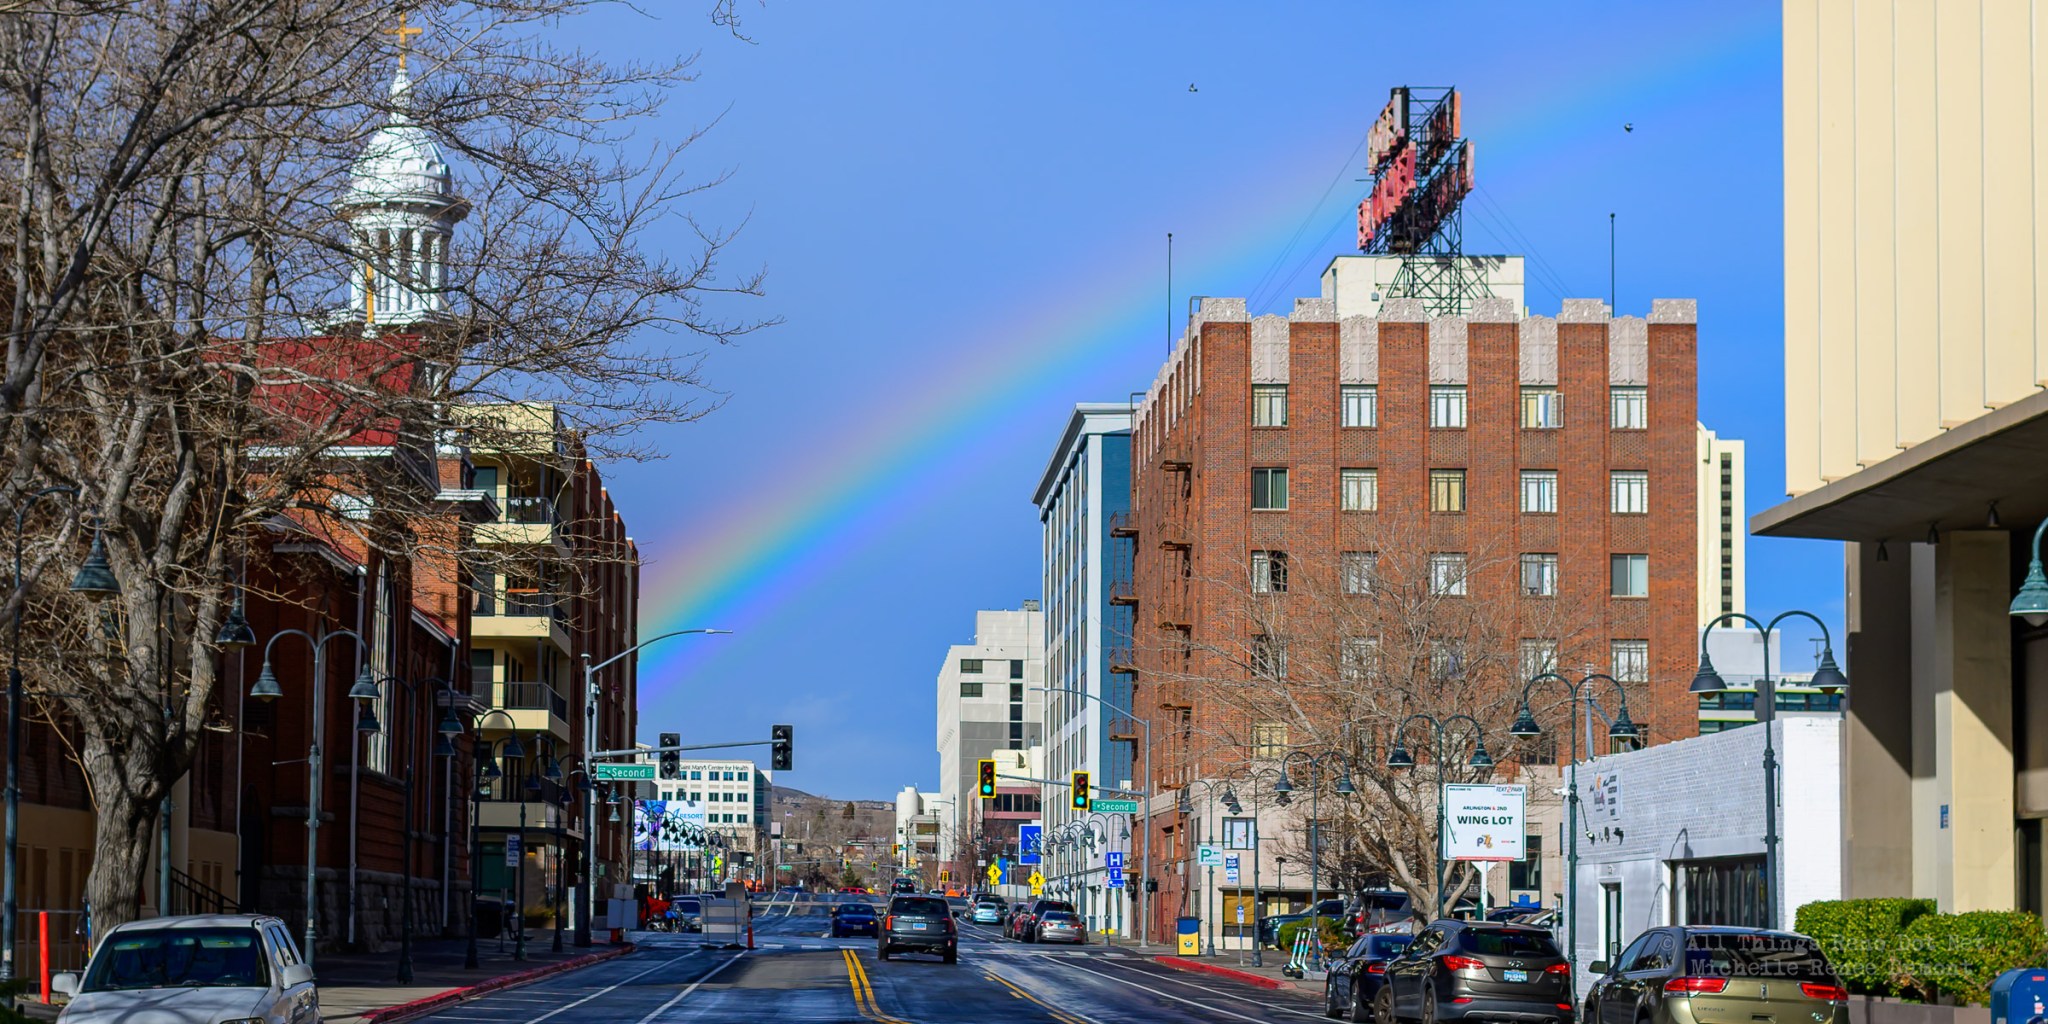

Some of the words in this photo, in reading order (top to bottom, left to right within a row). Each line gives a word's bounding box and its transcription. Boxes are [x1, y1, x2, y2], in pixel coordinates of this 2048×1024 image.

[611, 767, 646, 778] Second
[1101, 802, 1129, 811] Second
[1457, 815, 1489, 825] WING
[1492, 816, 1513, 825] LOT
[1110, 853, 1121, 866] H
